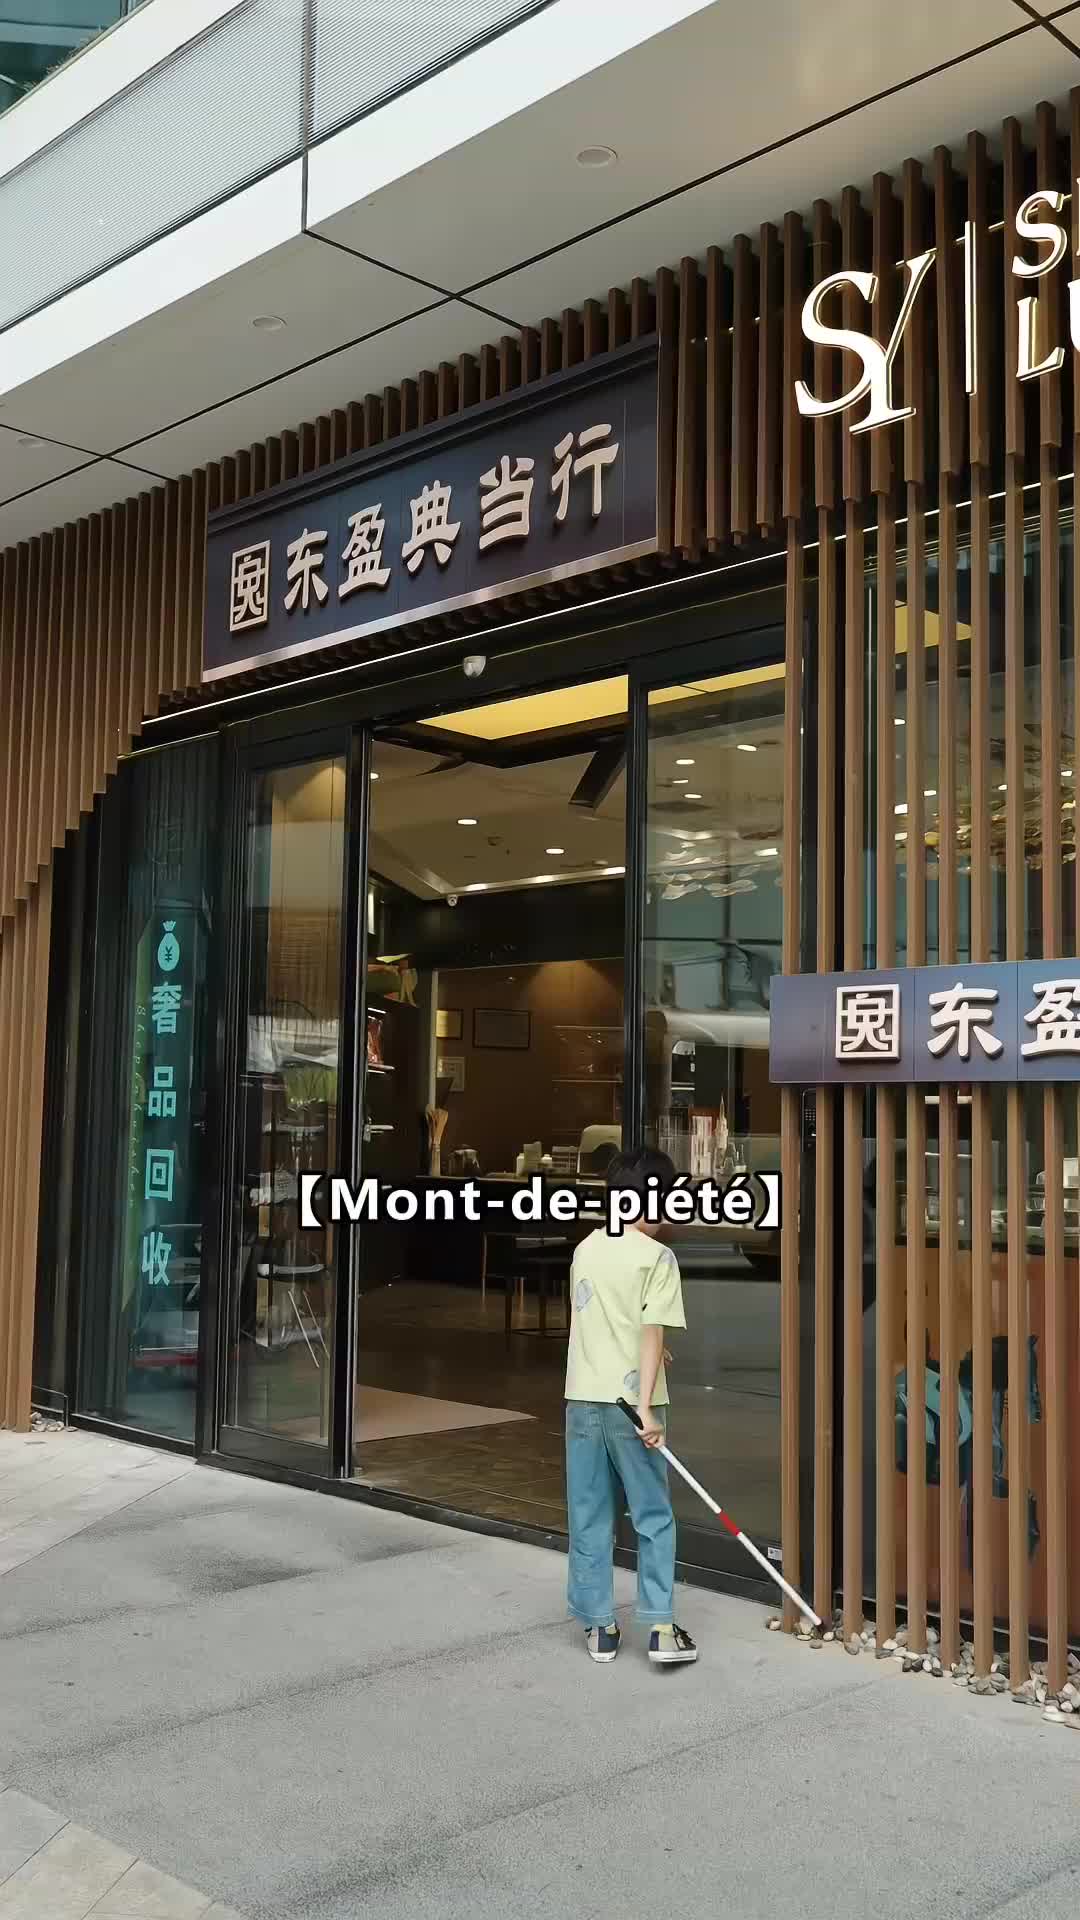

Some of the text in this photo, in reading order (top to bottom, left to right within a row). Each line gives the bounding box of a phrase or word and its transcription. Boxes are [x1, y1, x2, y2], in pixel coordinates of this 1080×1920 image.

[795, 248, 937, 434] SY
[284, 424, 619, 610] 东盈典当行
[142, 981, 182, 1286] 奢品回收
